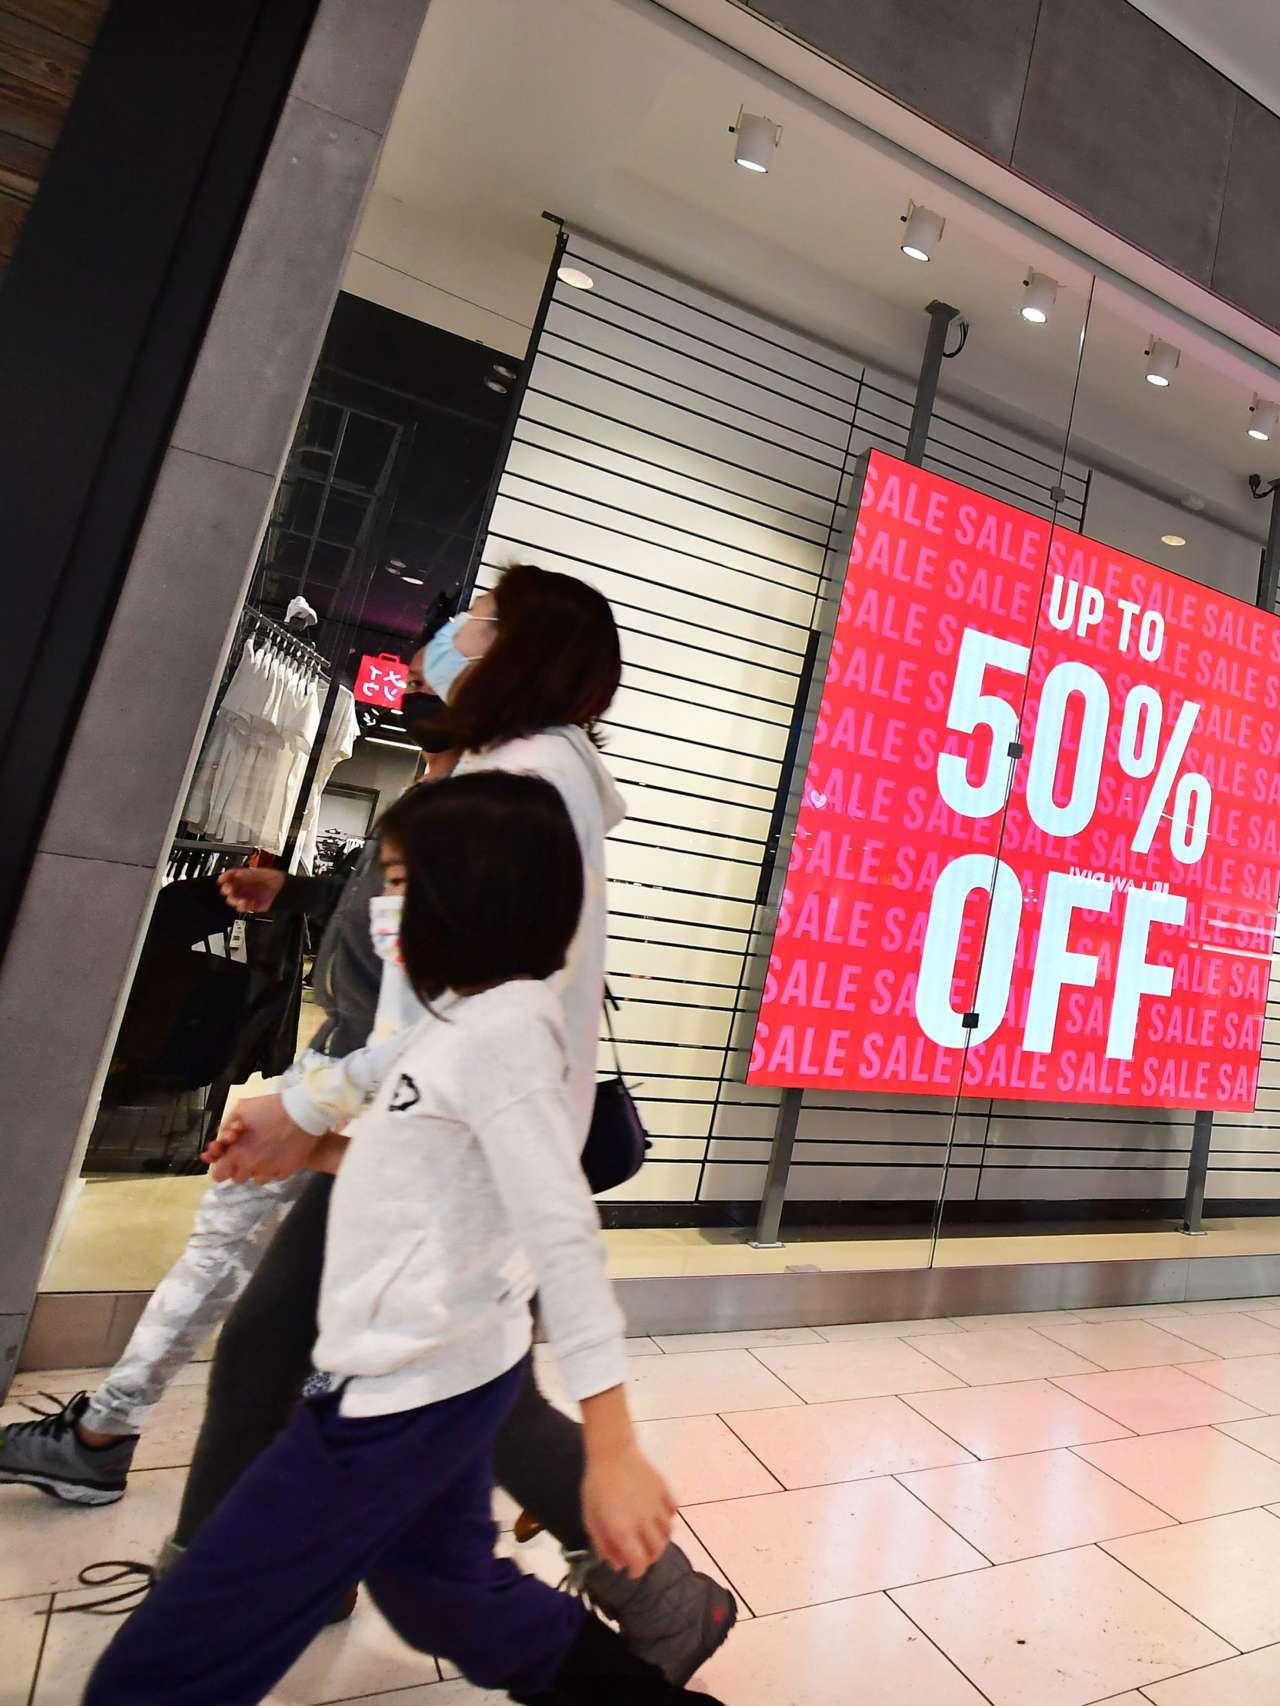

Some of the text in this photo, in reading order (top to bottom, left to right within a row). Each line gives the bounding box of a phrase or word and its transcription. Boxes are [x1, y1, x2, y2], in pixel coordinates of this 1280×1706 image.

[943, 557, 1032, 624] SALE
[1195, 648, 1259, 703] SALE
[953, 502, 1040, 571] SALE
[1047, 540, 1122, 602] SALE
[1127, 572, 1196, 631] SALE
[1201, 601, 1264, 657] SALE
[1047, 574, 1166, 664] UP TO
[935, 627, 1213, 863] 50%
[1089, 827, 1163, 880] SALE
[1168, 846, 1236, 895] SALE
[915, 855, 1187, 1060] OFF
[858, 1032, 958, 1083] SALE
[965, 1041, 1051, 1089] SALE
[1057, 1050, 1135, 1095] SALE
[1140, 1057, 1211, 1100] SALE
[1147, 1003, 1217, 1047] SALE
